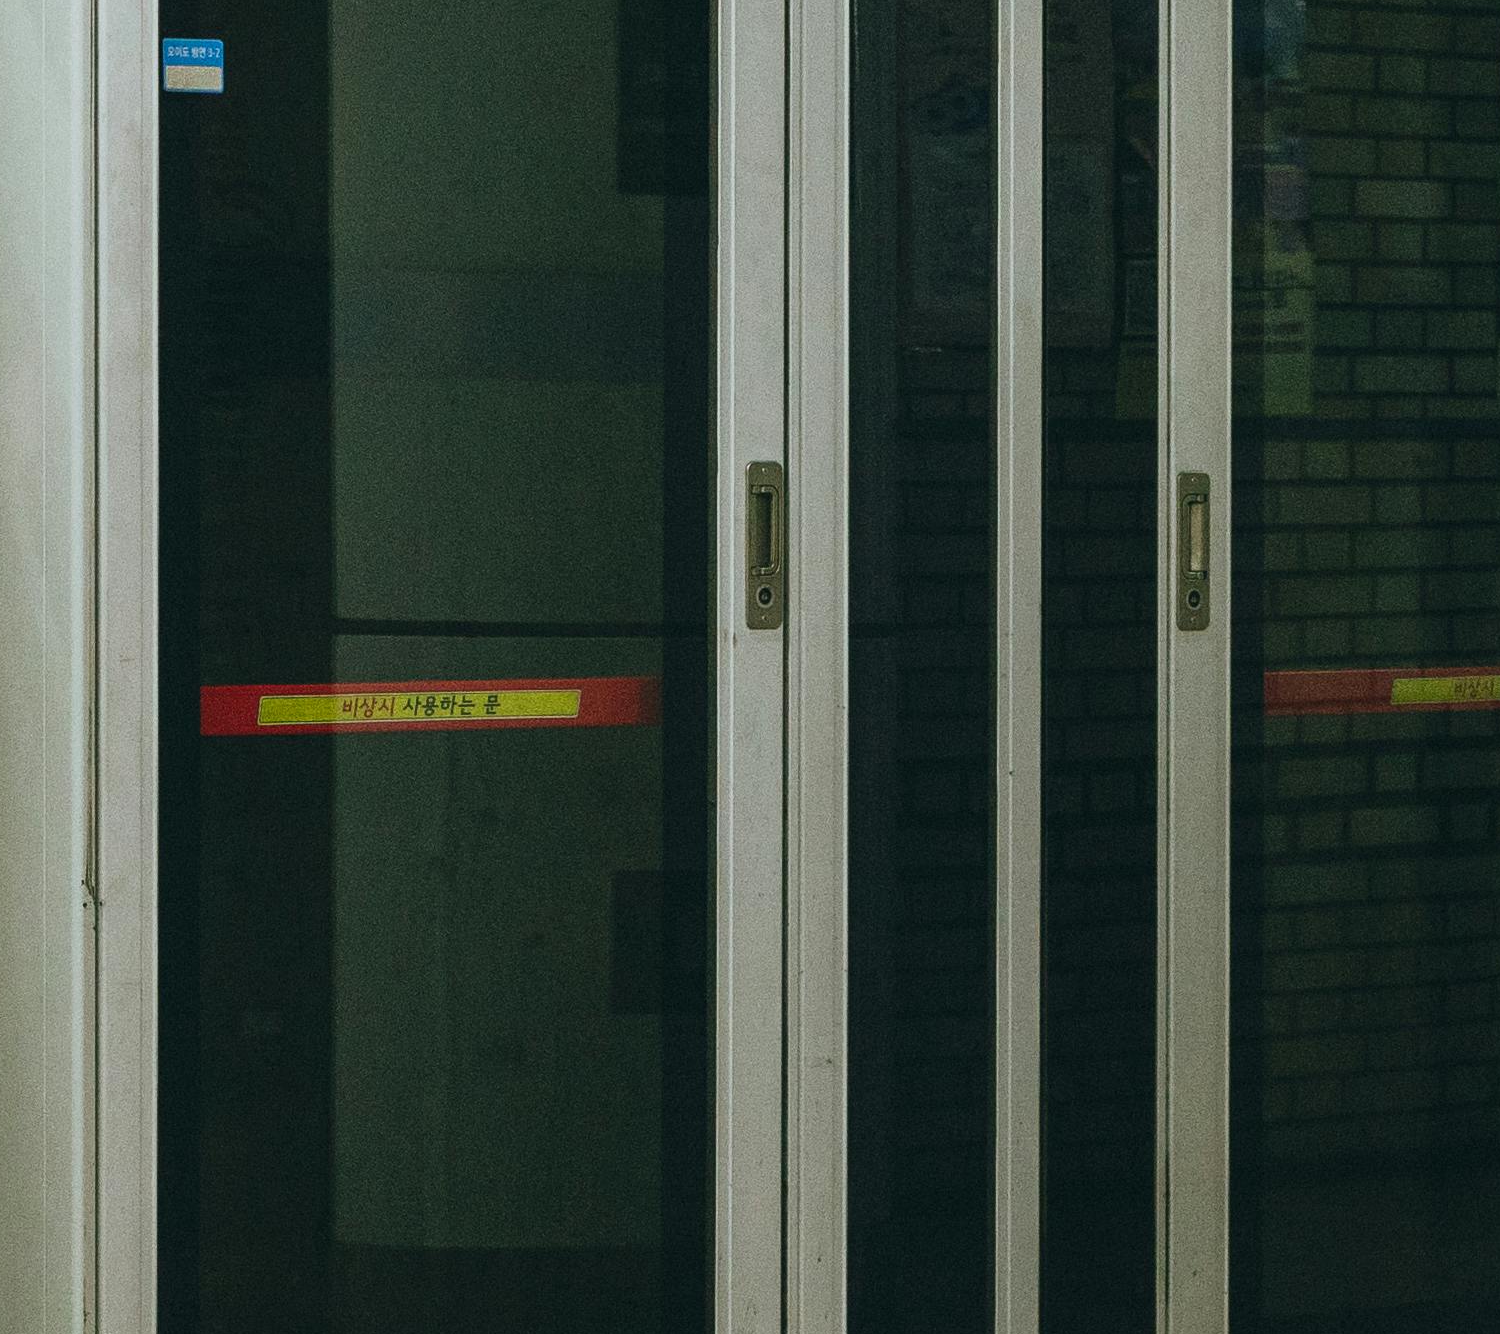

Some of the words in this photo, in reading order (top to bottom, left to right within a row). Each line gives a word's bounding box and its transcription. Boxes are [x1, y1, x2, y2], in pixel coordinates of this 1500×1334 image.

[341, 697, 396, 718] 비상시
[402, 696, 476, 717] 사용하는
[483, 695, 501, 715] 문
